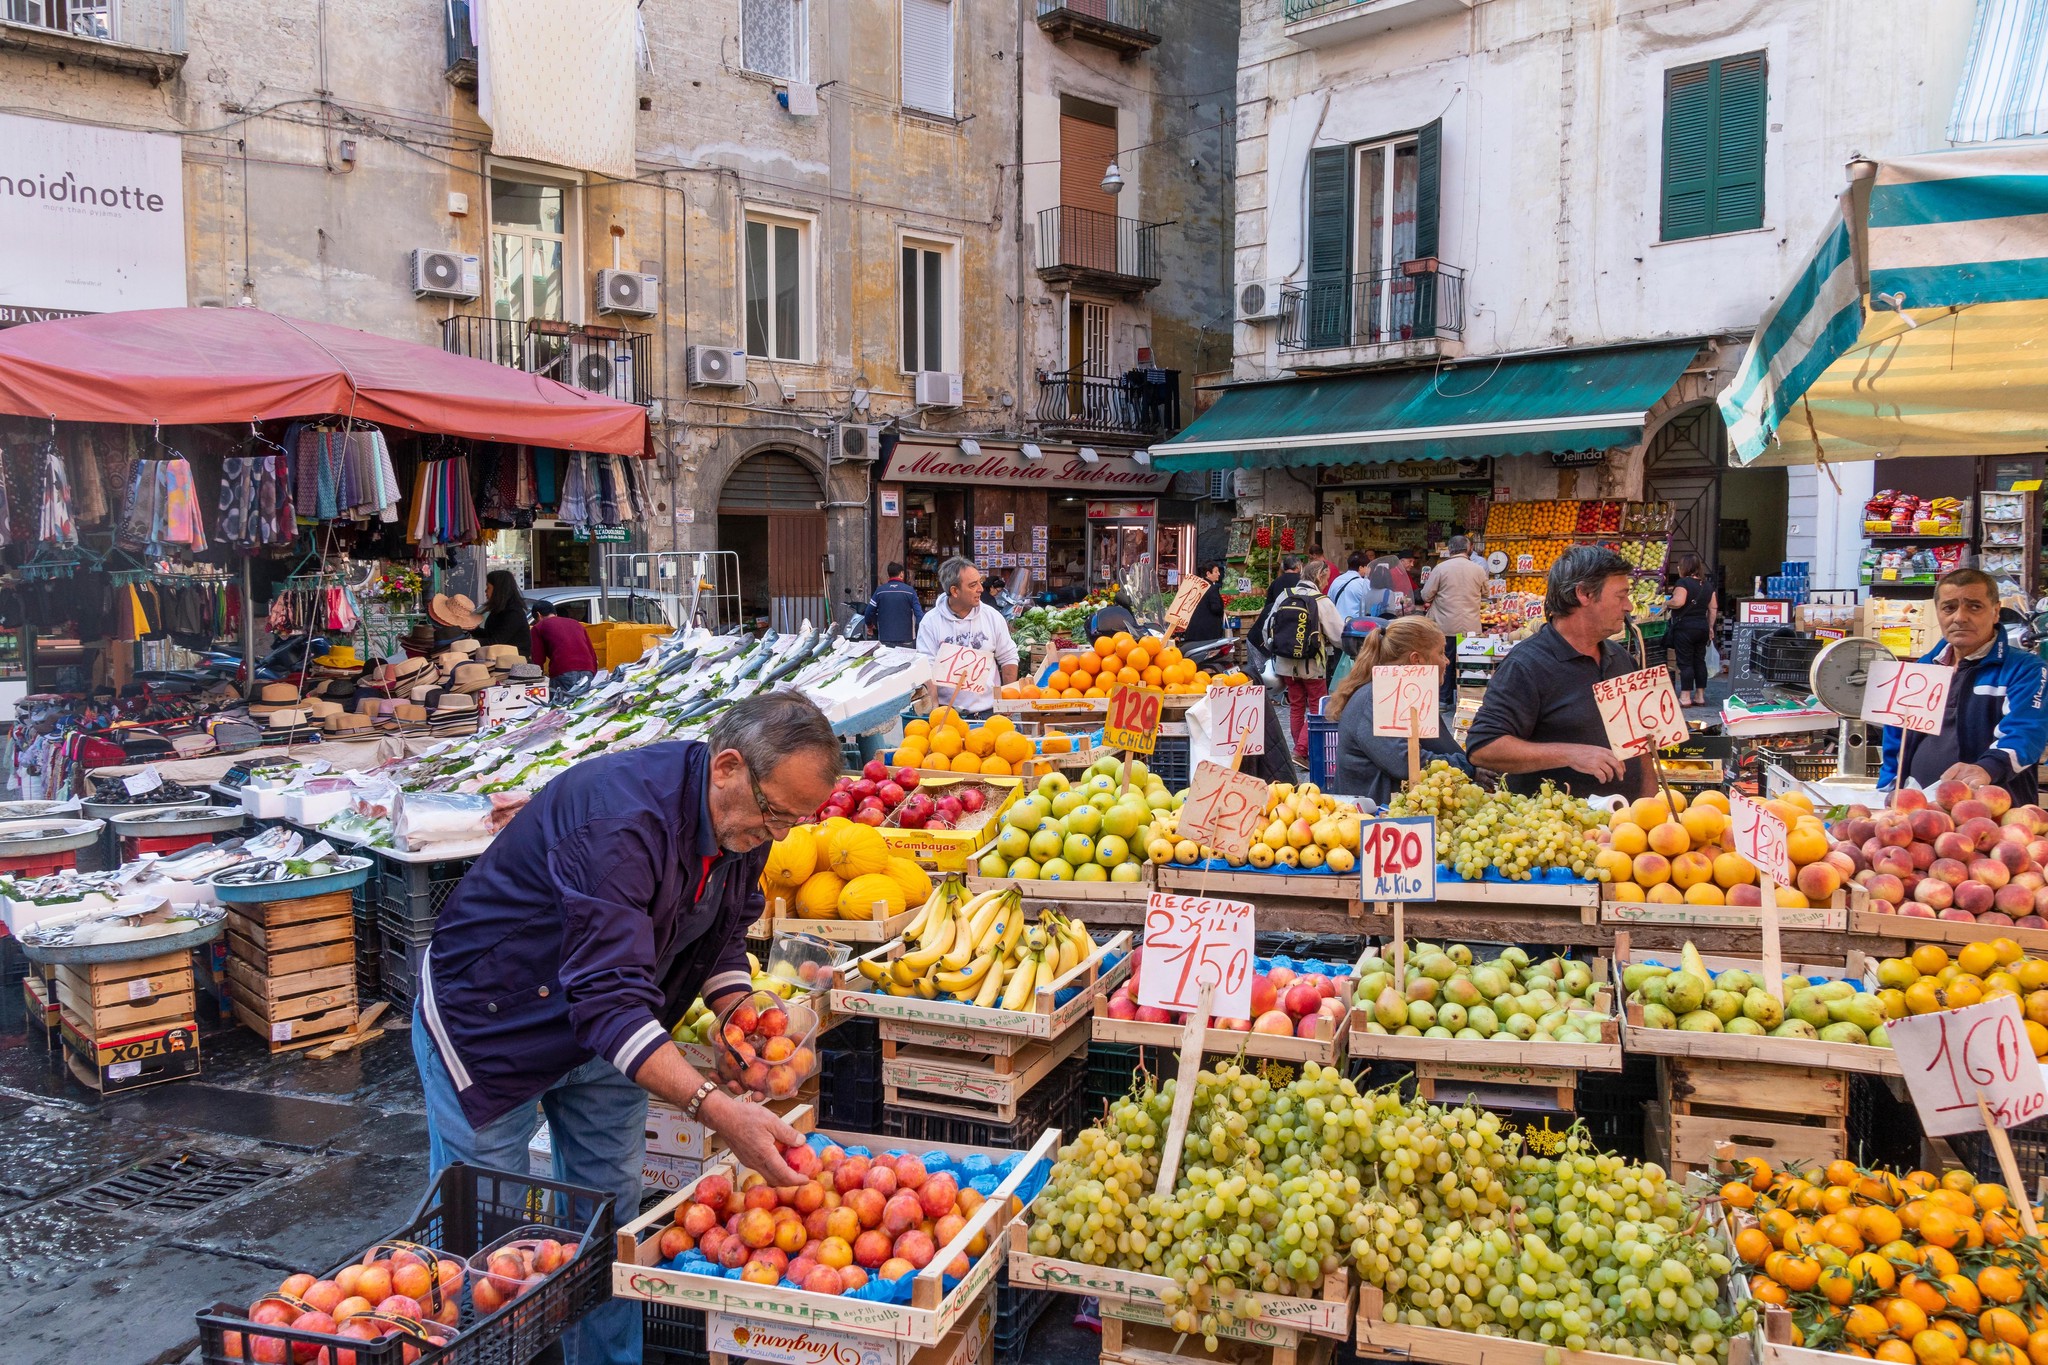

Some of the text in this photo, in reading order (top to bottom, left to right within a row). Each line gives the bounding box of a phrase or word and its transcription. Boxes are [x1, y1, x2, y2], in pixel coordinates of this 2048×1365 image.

[43, 204, 64, 212] more
[67, 206, 87, 215] than
[899, 451, 1159, 484] Macelleria Lubrano
[1552, 449, 1602, 462] Melinda
[1293, 612, 1308, 658] BILLABONG
[1816, 629, 1842, 639] SPECIALE
[936, 647, 987, 685] 120
[1373, 666, 1435, 677] PAESANI
[1593, 665, 1668, 693] PERCOCHE
[1210, 686, 1263, 699] OFFERTA
[1597, 678, 1657, 703] VERACI
[1872, 661, 1943, 714] 120
[1111, 685, 1159, 732] 120
[1379, 678, 1433, 730] 120
[1609, 689, 1675, 748] 160
[1216, 696, 1259, 746] 160
[1198, 761, 1269, 792] OFFERTA
[1189, 781, 1260, 837] 120
[1731, 790, 1785, 831] OFFERTA
[894, 841, 956, 852] Cambayas
[1364, 823, 1422, 878] 120
[1743, 814, 1785, 866] 120
[1375, 876, 1391, 895] AL
[1150, 894, 1249, 918] REGGINA
[1622, 910, 1764, 923] Melami
[1146, 909, 1182, 949] 2
[1158, 933, 1247, 1008] 150
[849, 1000, 987, 1026] Melamia
[996, 1016, 1027, 1028] Cerullo
[110, 1040, 159, 1063] FOX
[1926, 1015, 2019, 1112] 160
[632, 1279, 841, 1322] Melamia
[1269, 1303, 1318, 1317] Cerullo
[854, 1309, 900, 1324] Cerullo
[745, 1349, 796, 1361] ORTOFRUTTICOLA
[754, 1332, 861, 1365] Vingiani
